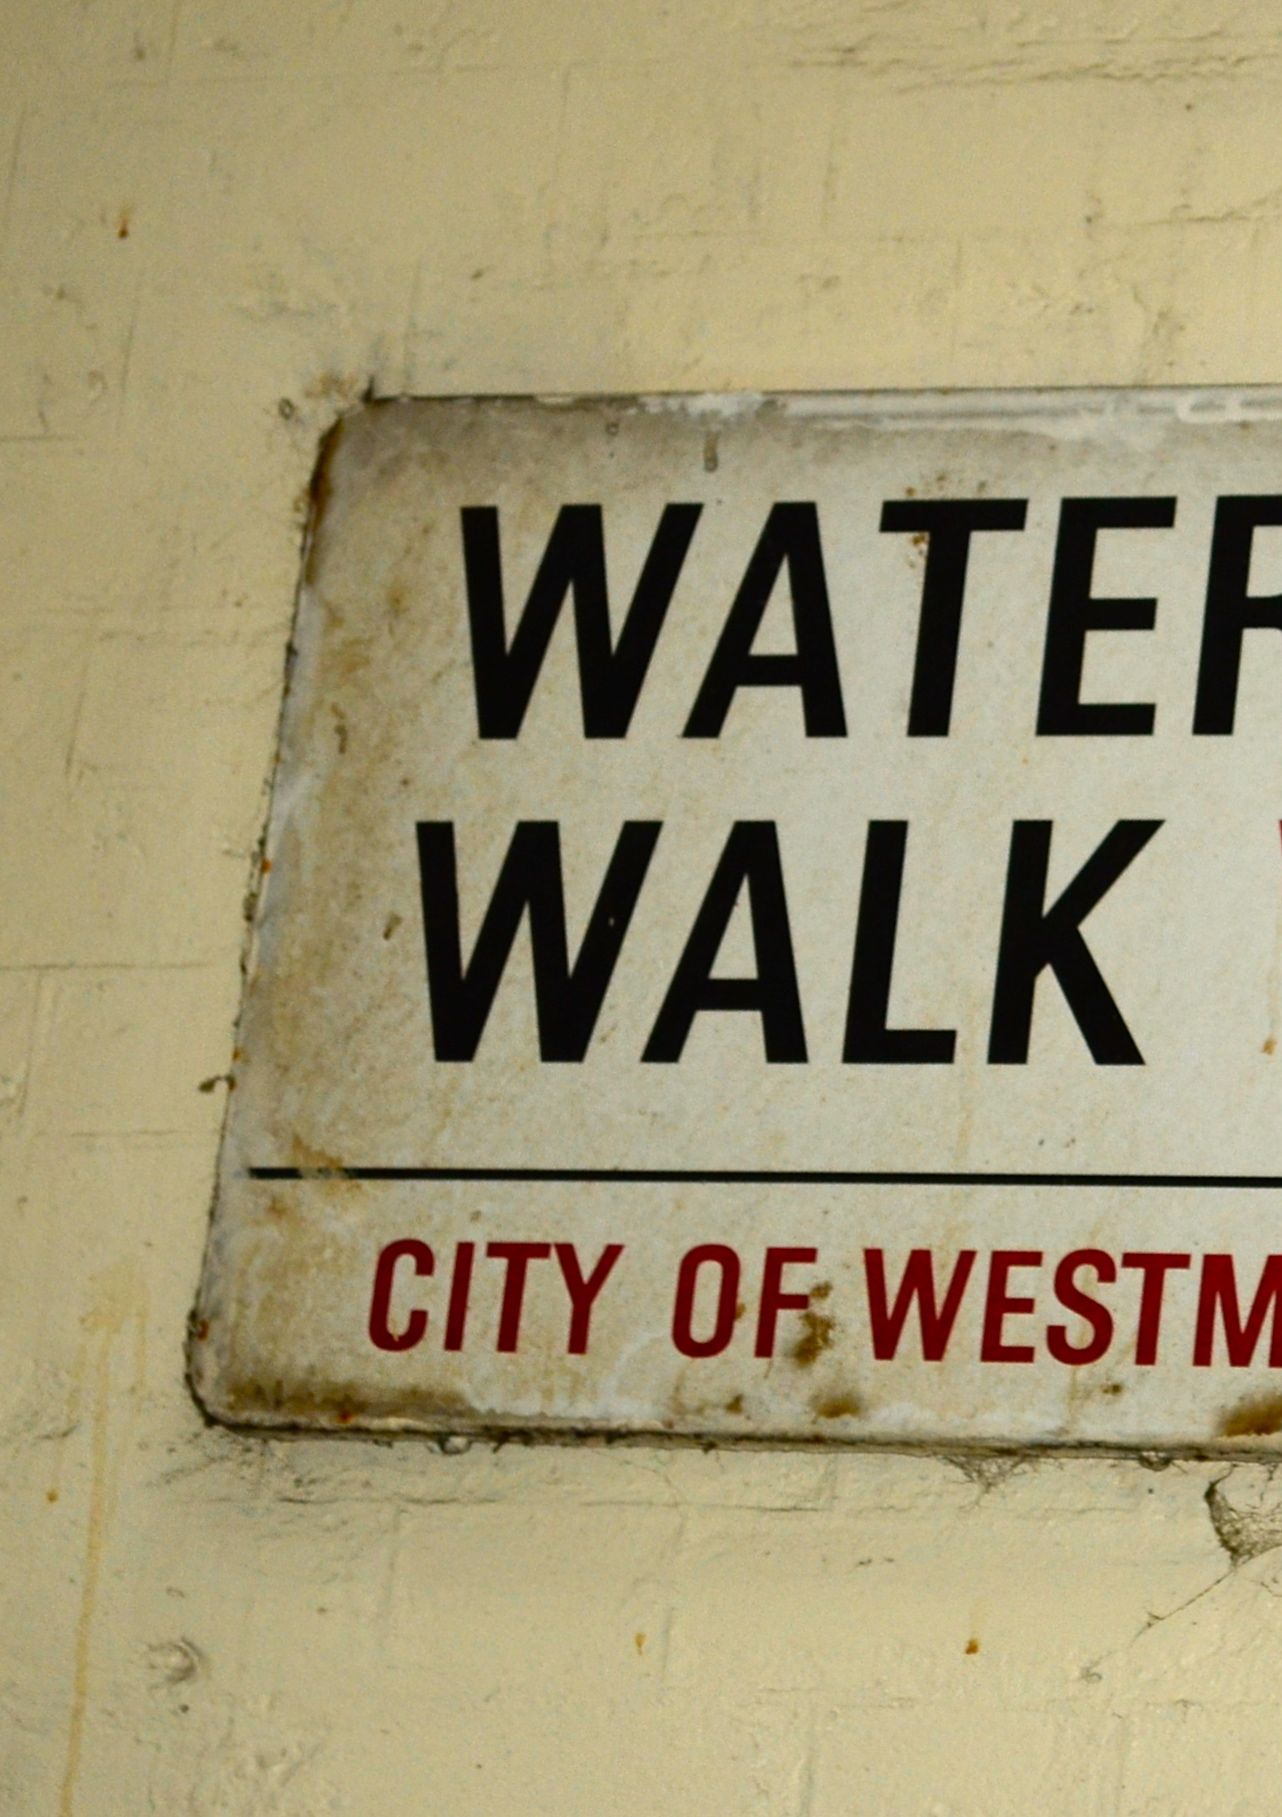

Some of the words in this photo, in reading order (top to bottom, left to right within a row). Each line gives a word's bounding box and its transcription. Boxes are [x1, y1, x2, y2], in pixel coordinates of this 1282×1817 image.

[415, 819, 1165, 1066] WALK
[368, 1238, 624, 1355] CITY
[671, 1243, 818, 1358] OF
